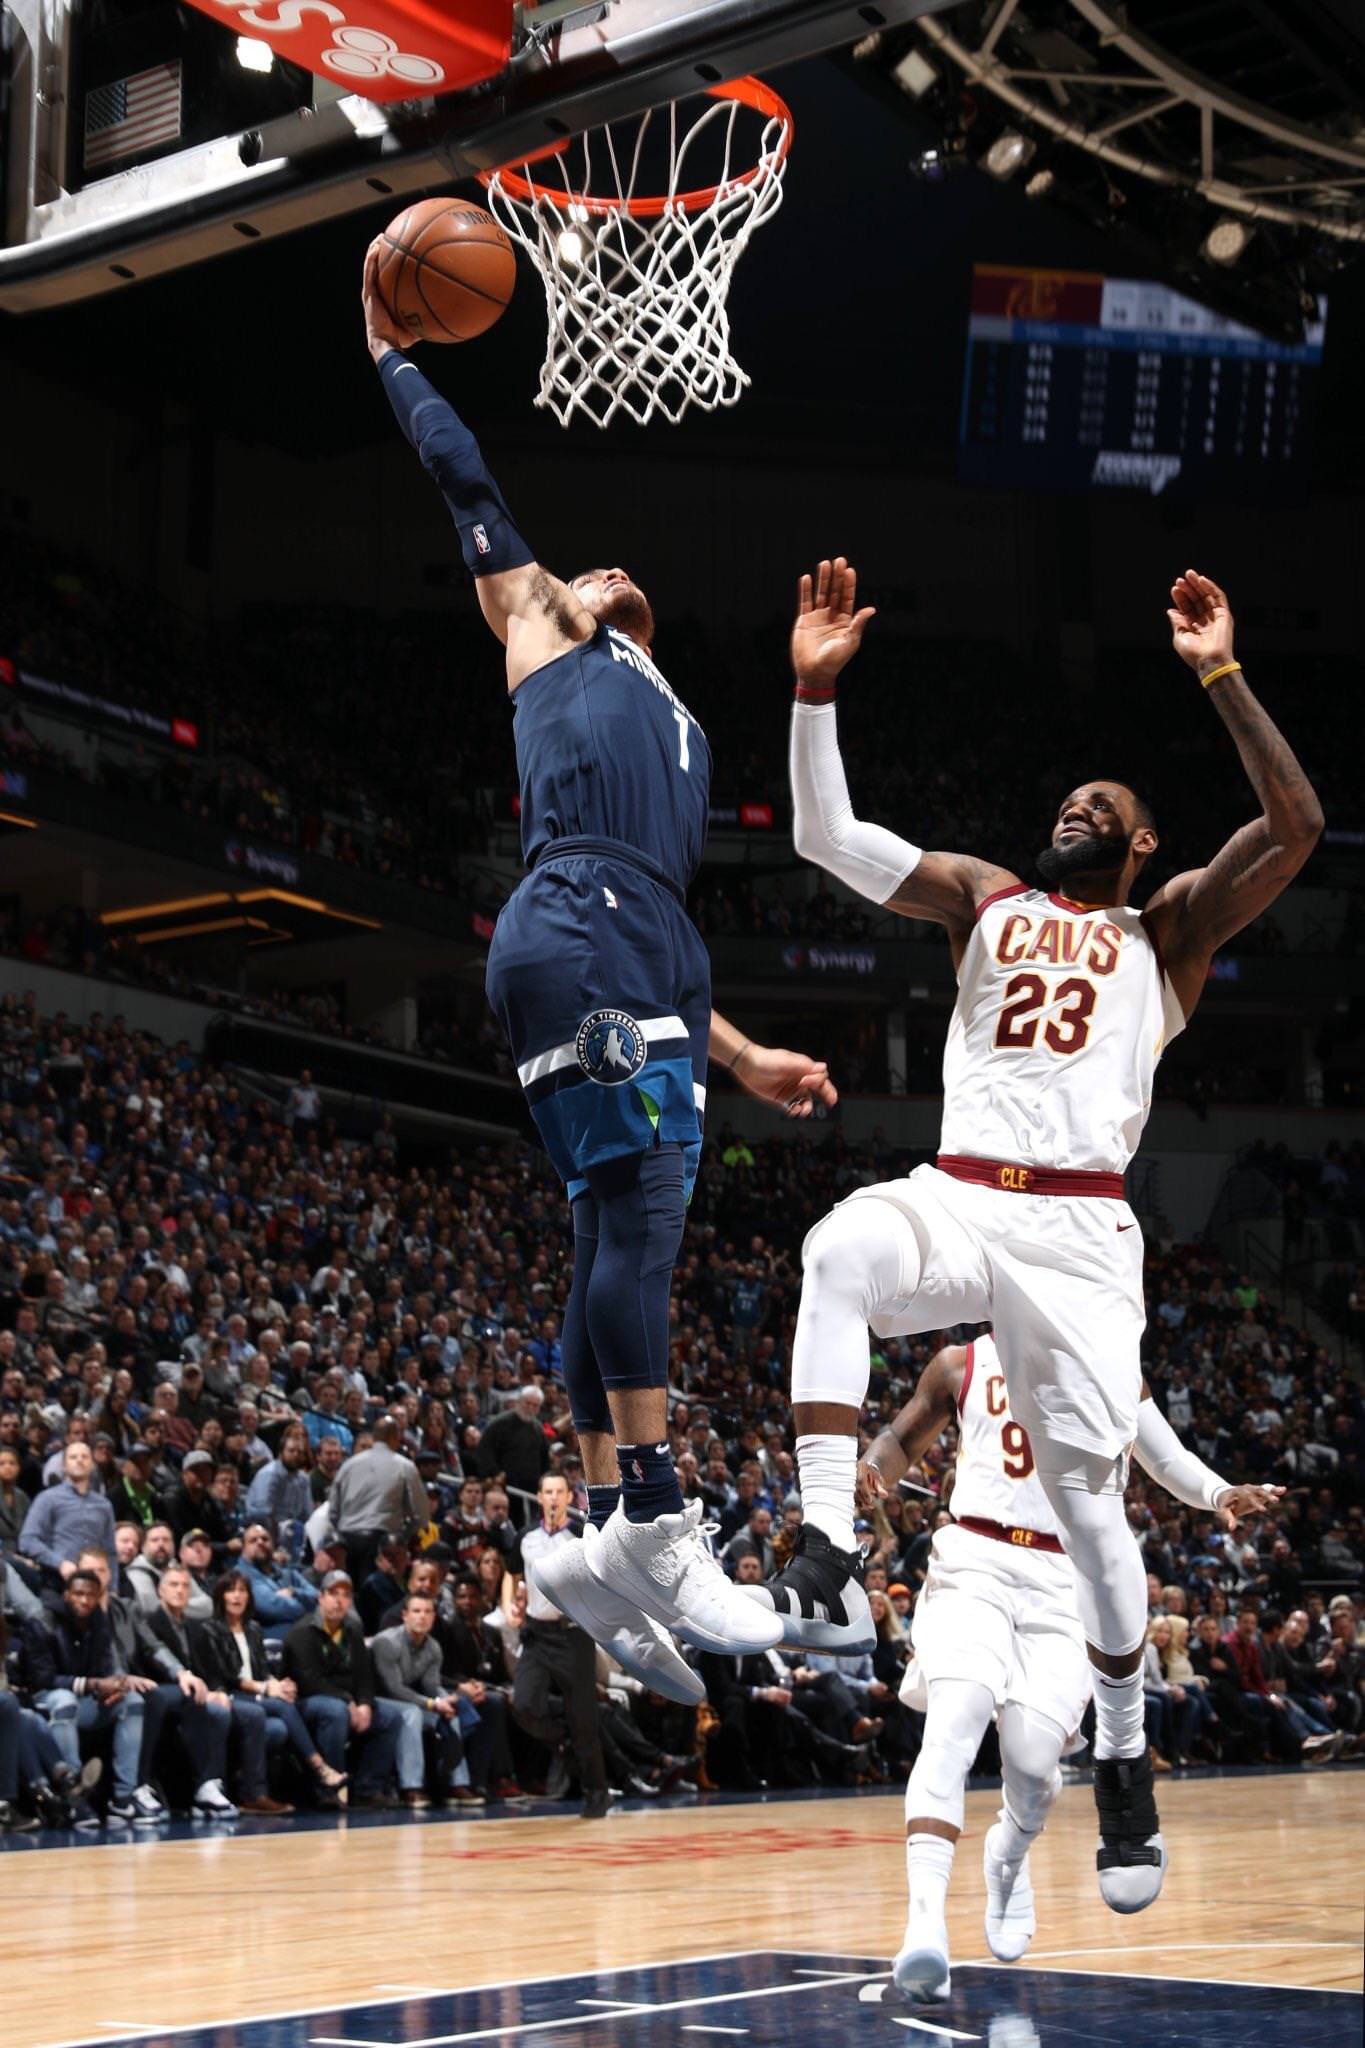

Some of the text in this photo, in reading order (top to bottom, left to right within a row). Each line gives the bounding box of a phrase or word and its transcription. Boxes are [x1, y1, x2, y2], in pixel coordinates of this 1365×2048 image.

[808, 946, 878, 975] Synergy
[995, 913, 1123, 976] CAVS
[578, 1012, 645, 1071] MINNESOTA TIMBERWOLVES
[994, 972, 1097, 1055] 23
[1000, 1167, 1028, 1189] CLE
[1001, 1420, 1035, 1479] 9
[1011, 1528, 1034, 1547] CLE
